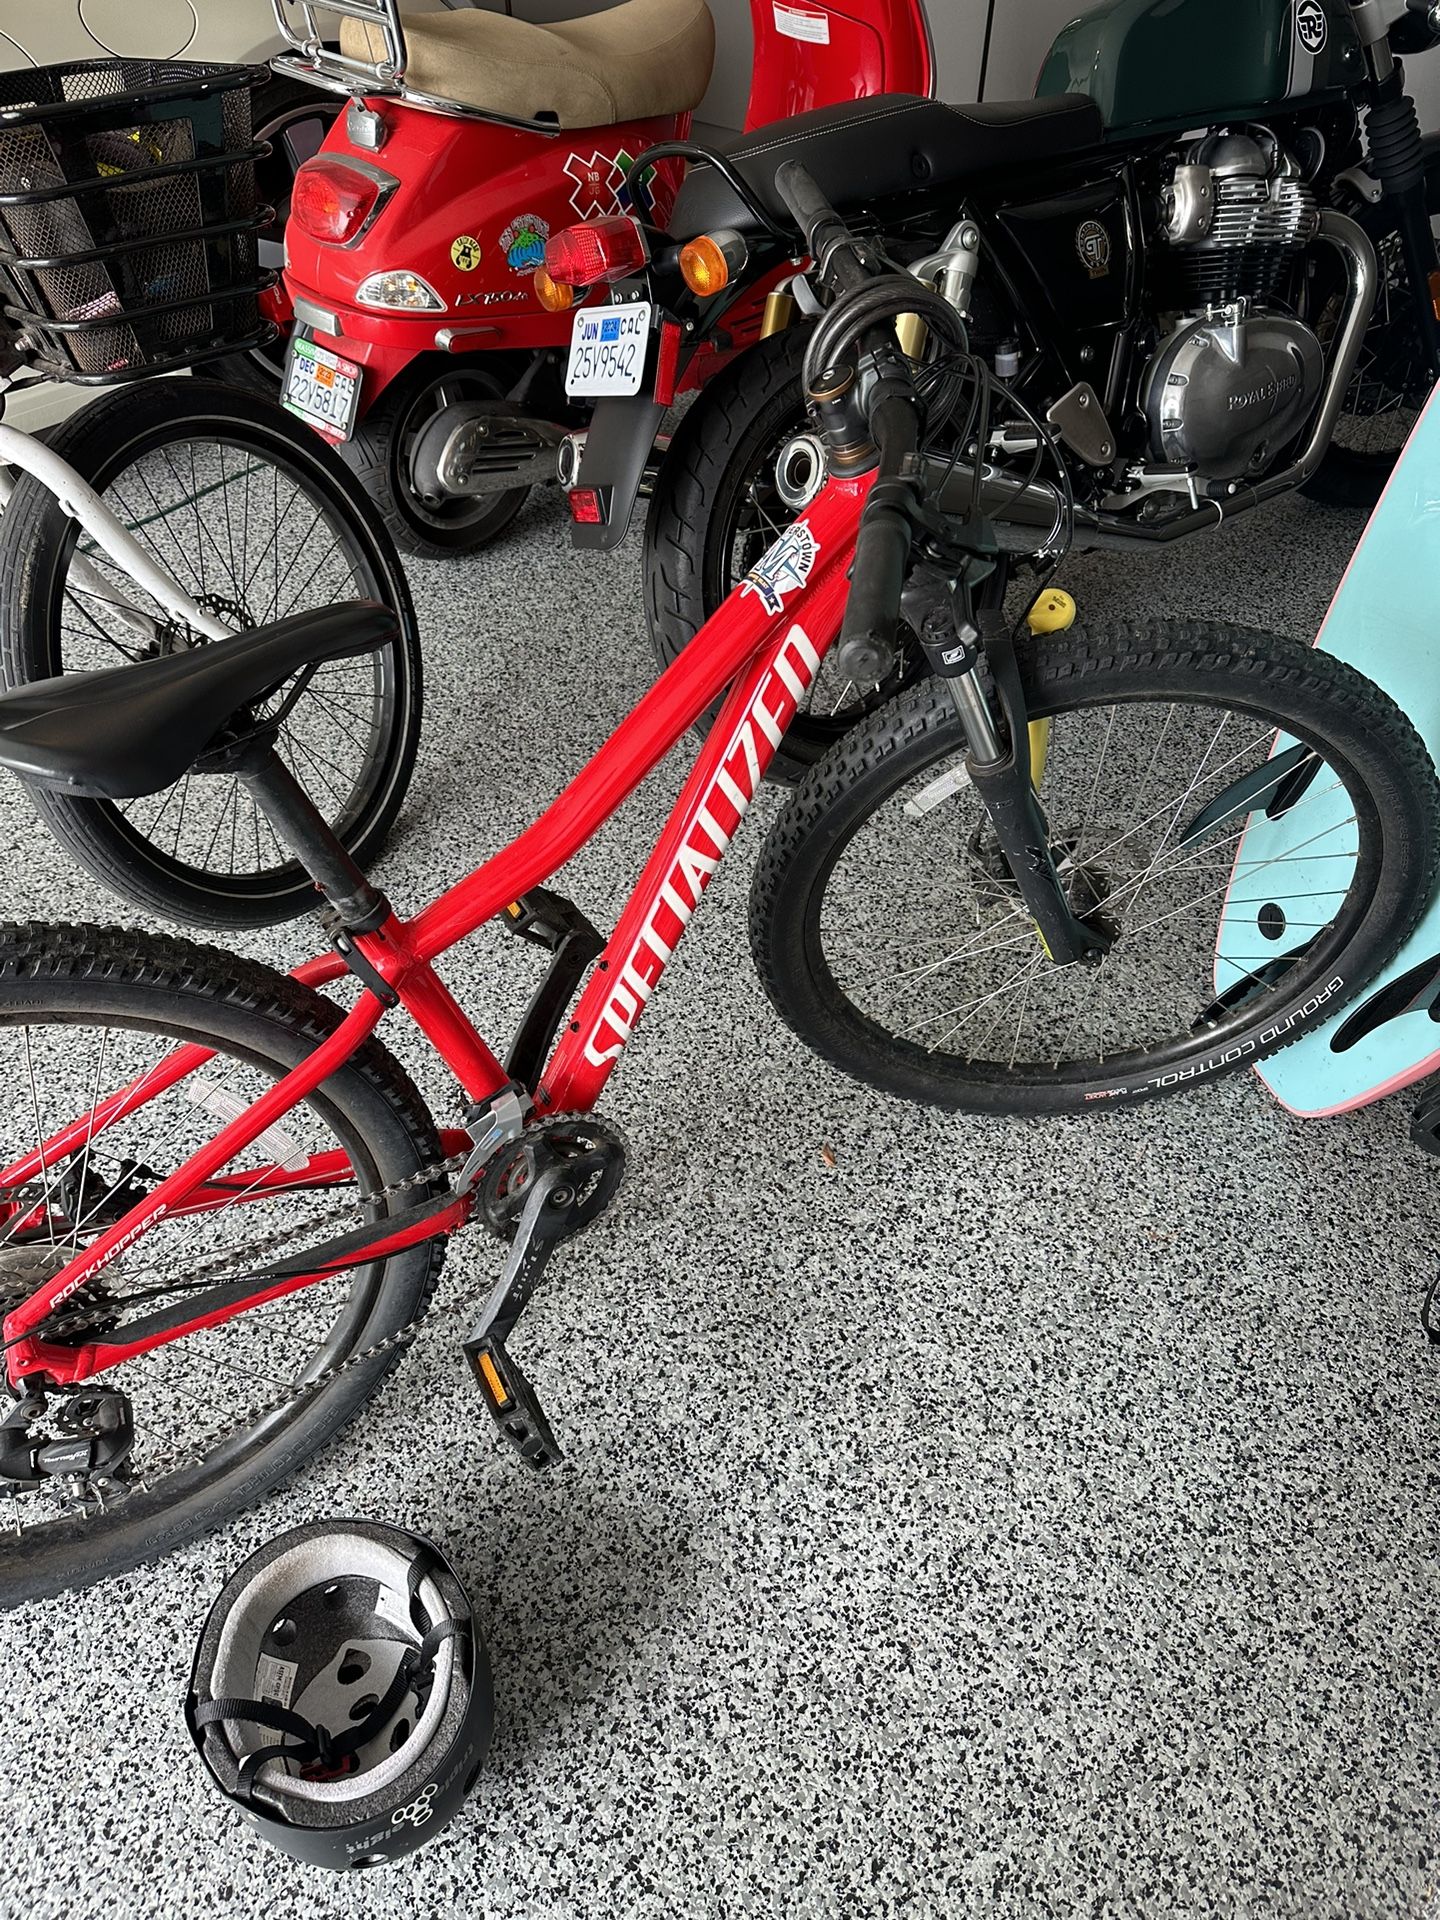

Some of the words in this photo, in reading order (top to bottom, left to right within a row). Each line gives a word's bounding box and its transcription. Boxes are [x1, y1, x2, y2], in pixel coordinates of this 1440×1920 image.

[587, 172, 600, 182] NB
[581, 322, 599, 341] JUN
[621, 317, 640, 335] CAL
[300, 357, 315, 375] DEC
[573, 343, 636, 379] 25V9542
[289, 374, 349, 421] 22V5817
[1227, 388, 1266, 411] ROYAL
[584, 623, 821, 1067] SPECIALIZED
[1259, 975, 1345, 1045] GROUND
[1147, 1039, 1257, 1089] CONTROL
[49, 1203, 167, 1309] ROCKHOPPER
